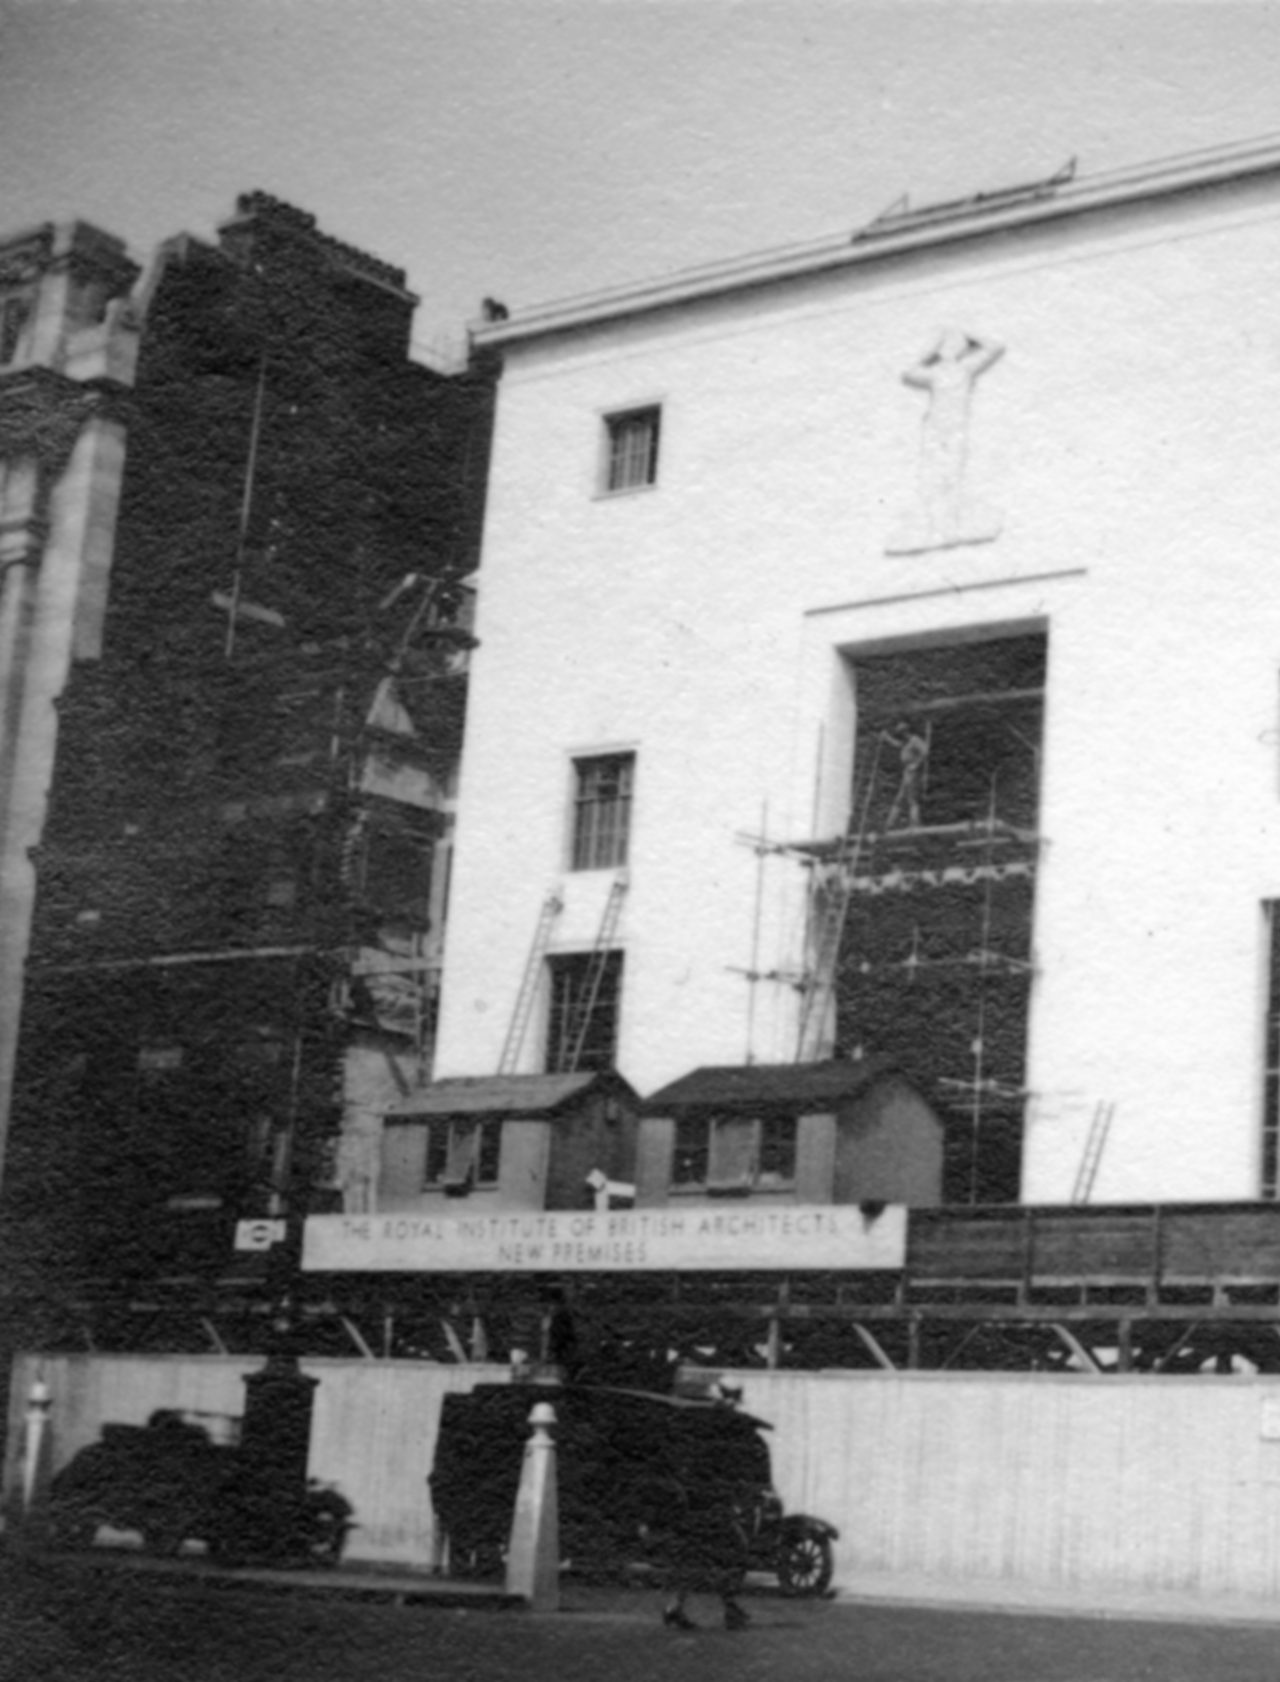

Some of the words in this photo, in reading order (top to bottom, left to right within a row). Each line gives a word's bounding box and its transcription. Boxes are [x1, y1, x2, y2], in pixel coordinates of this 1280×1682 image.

[342, 1219, 371, 1240] THE
[384, 1219, 443, 1240] ROYAL
[457, 1218, 556, 1239] INSTITUTE
[571, 1217, 595, 1238] OF
[607, 1216, 684, 1237] BRITISH
[699, 1214, 838, 1236] ARCHITECTS
[498, 1242, 541, 1264] NEW
[552, 1241, 647, 1264] PREMISES
